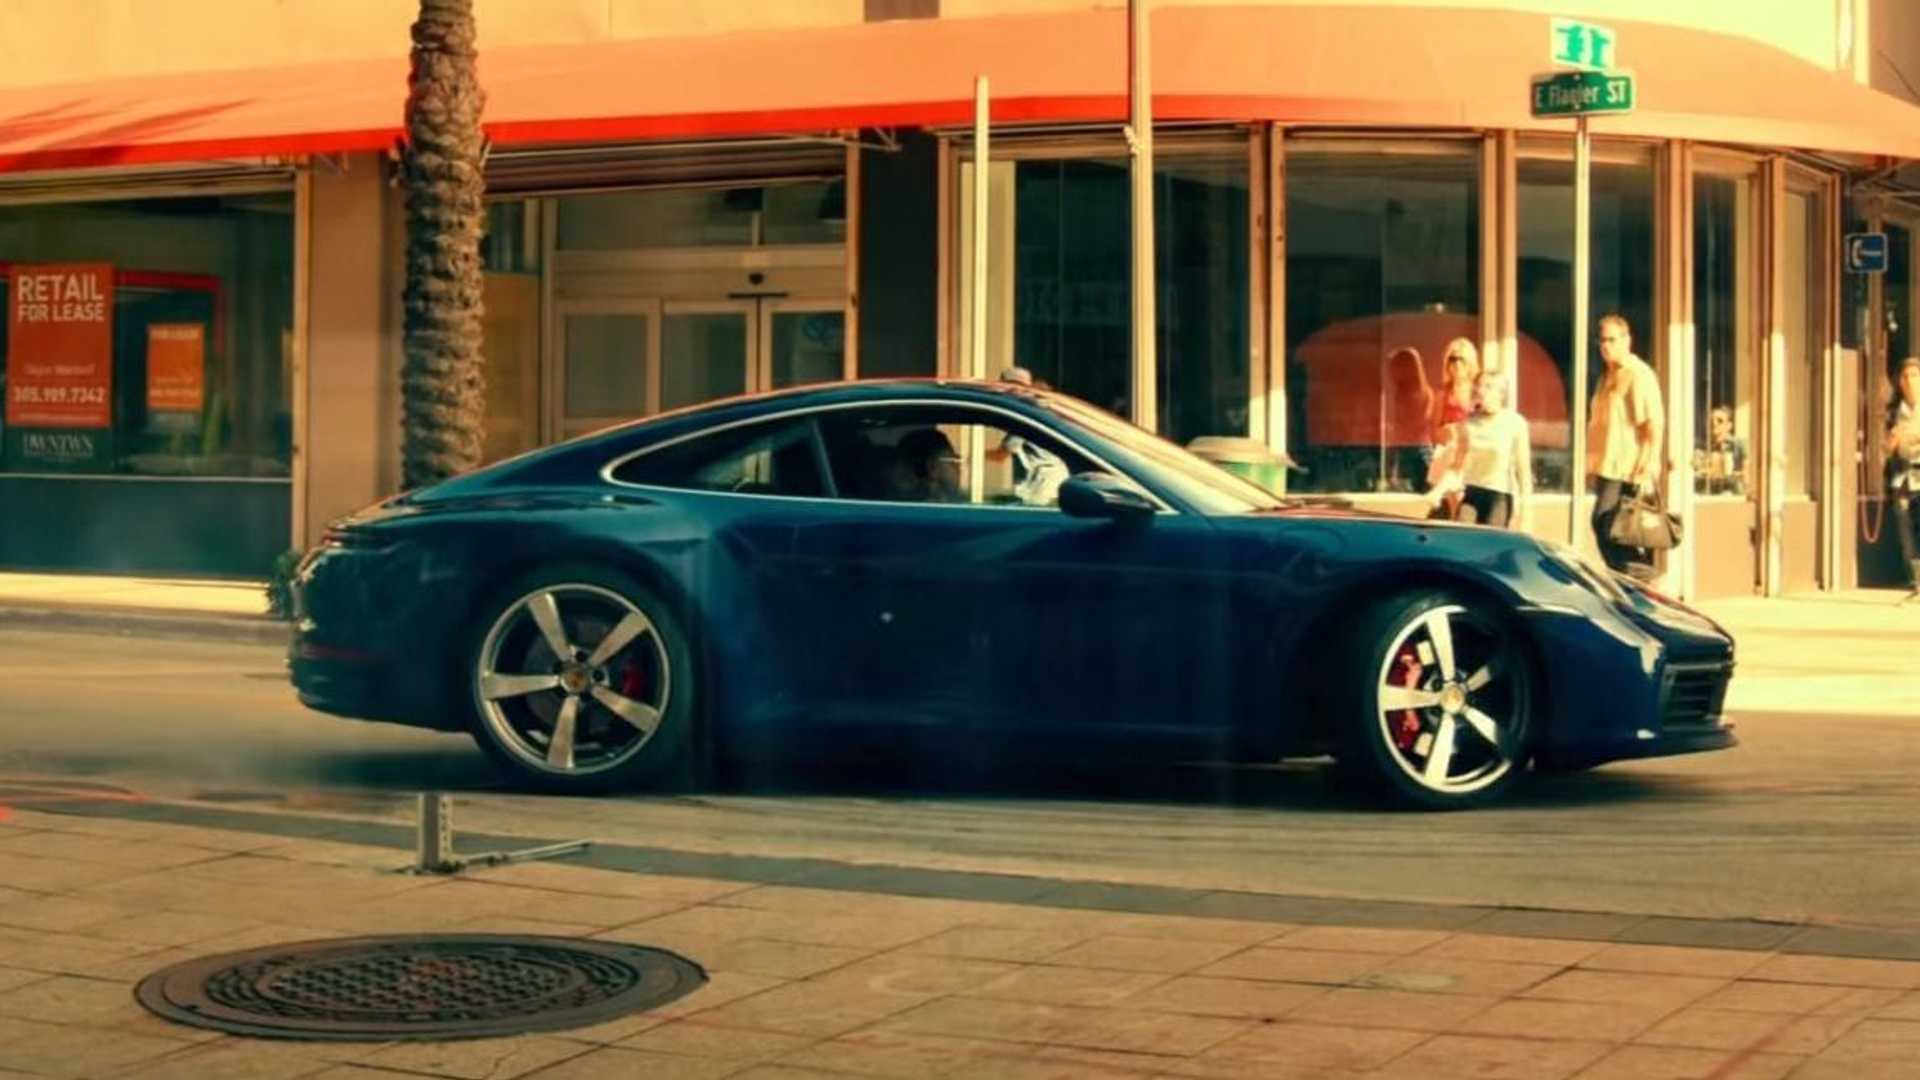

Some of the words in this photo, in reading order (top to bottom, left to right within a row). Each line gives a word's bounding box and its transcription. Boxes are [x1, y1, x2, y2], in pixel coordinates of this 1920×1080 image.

[1535, 85, 1545, 108] E
[1606, 80, 1627, 104] ST
[18, 273, 104, 301] RETAIL
[18, 303, 48, 322] FOR
[52, 303, 104, 322] LEASE
